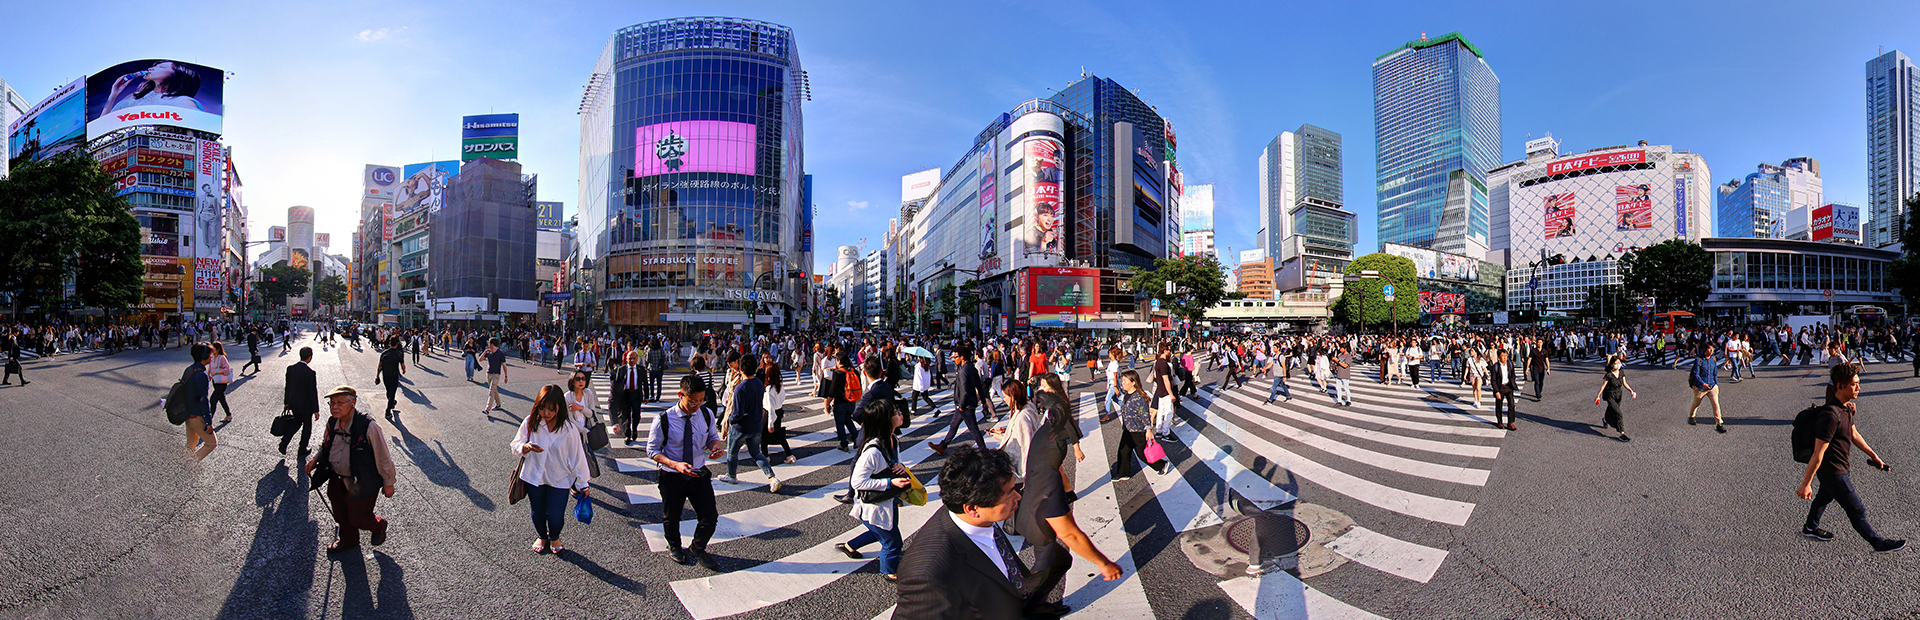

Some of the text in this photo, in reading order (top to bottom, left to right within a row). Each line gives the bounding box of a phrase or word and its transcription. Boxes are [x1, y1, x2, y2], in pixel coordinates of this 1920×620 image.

[20, 84, 76, 125] JAPAN AIRLINES
[116, 110, 184, 123] Yakult
[463, 121, 517, 130] Hisamitsu
[212, 142, 221, 163] EXILE
[464, 142, 515, 153] サロンパス
[138, 154, 183, 166] コンタクト
[202, 140, 212, 176] SHOKICHI
[1552, 156, 1608, 173] 日本ダービー
[169, 169, 190, 178] ガスト
[374, 171, 393, 183] UC
[294, 208, 310, 219] 109
[538, 204, 553, 218] 21
[554, 219, 561, 227] 21
[1813, 214, 1832, 227] カラオケ
[1834, 227, 1859, 236] JOYSOUND
[196, 257, 220, 266] NEW
[642, 256, 738, 266] STARBUCKS COFFEE
[196, 276, 220, 286] 5.15
[727, 289, 778, 301] TSUAYA
